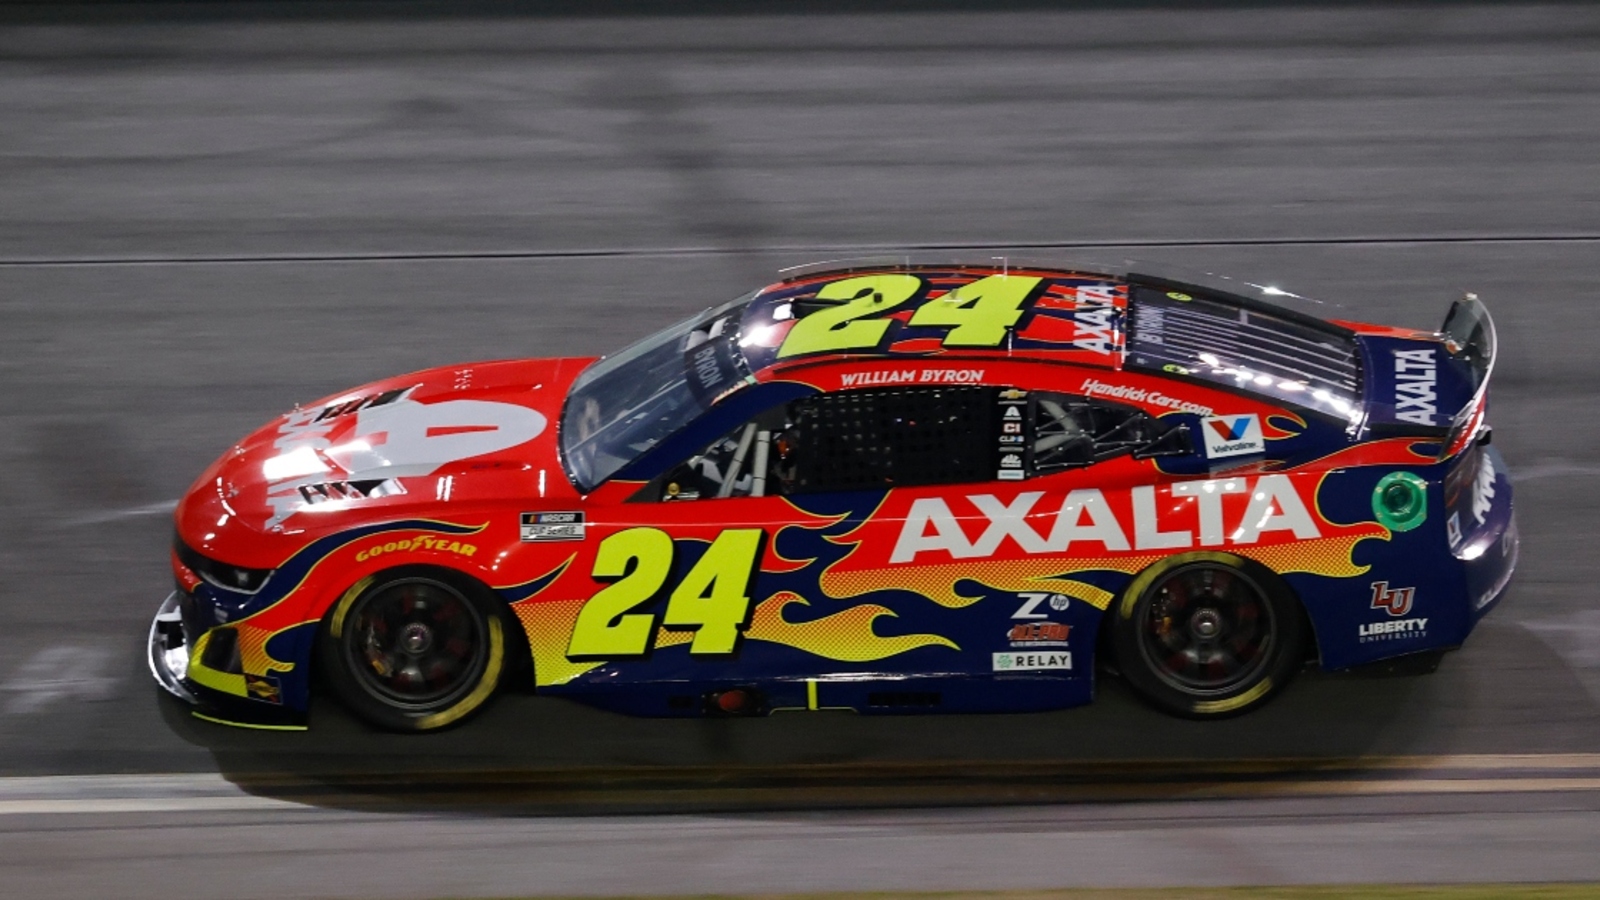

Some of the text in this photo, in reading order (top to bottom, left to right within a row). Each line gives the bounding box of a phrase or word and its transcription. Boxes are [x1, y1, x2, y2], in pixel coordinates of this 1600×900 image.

[775, 273, 1043, 360] 24
[1073, 285, 1117, 356] AXALTA
[693, 346, 724, 389] BYRON
[840, 369, 985, 387] WILLIAM BYRON
[1395, 349, 1437, 427] AXALTA
[263, 402, 335, 531] AXTA
[888, 474, 1322, 564] AXALTA
[355, 535, 477, 562] GOODYEAR
[567, 526, 764, 658] 24
[1010, 592, 1049, 619] Z
[1370, 581, 1416, 616] LU
[1359, 618, 1429, 636] LIBERTY
[1359, 631, 1427, 643] UNIVERSITY
[1016, 655, 1068, 667] RELAY
